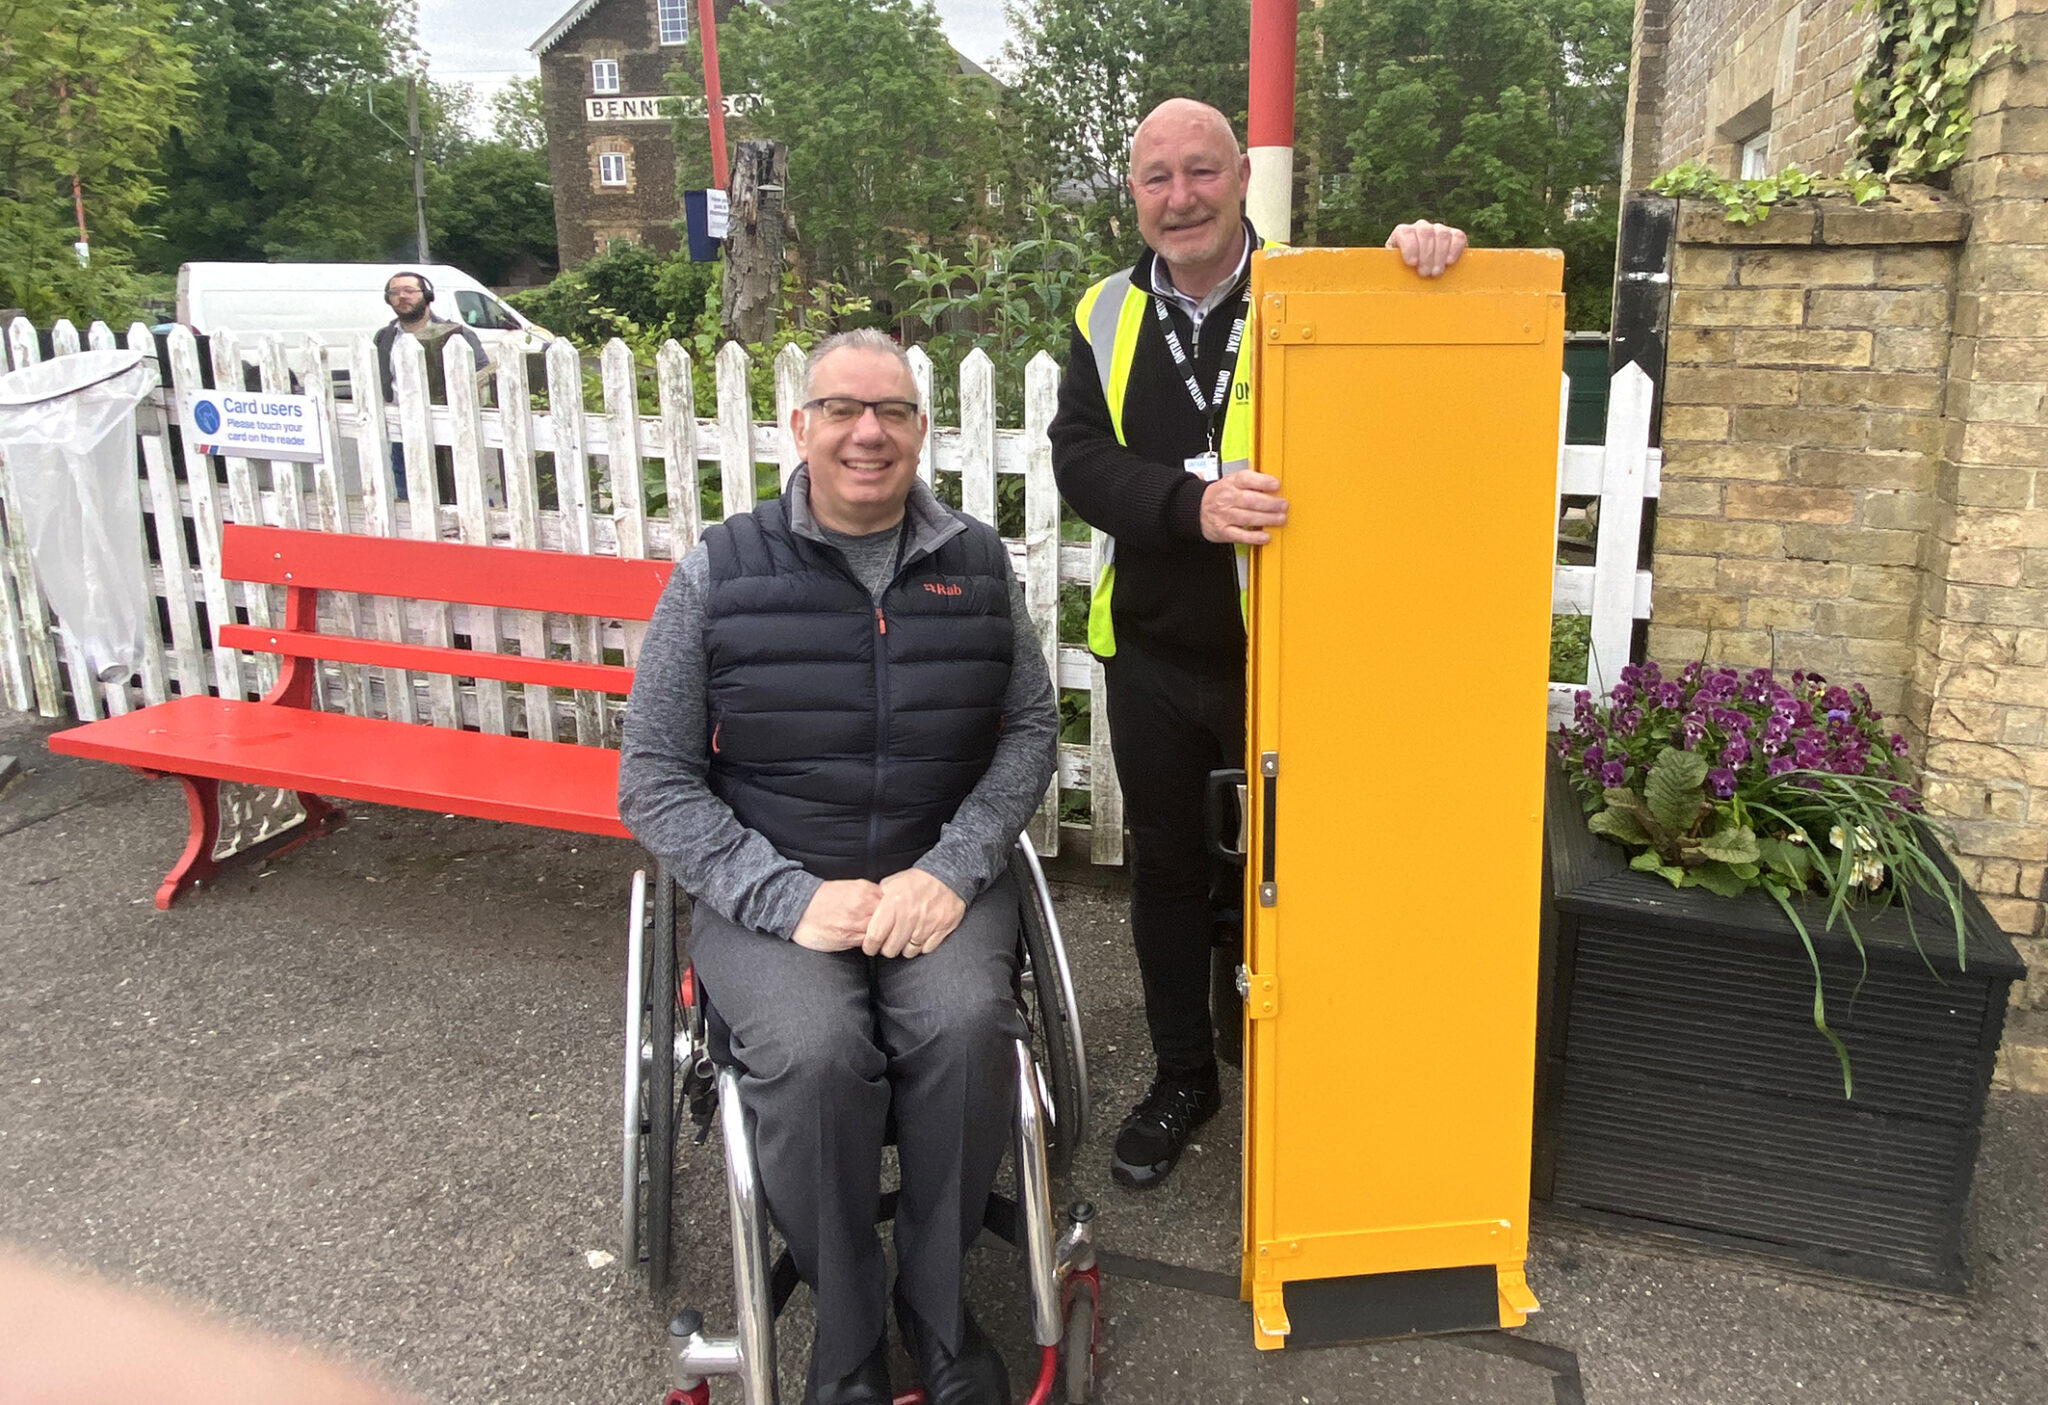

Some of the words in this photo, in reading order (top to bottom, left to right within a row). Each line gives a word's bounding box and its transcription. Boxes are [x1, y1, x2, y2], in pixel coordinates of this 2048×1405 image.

[1165, 330, 1187, 365] ONTRAK
[1225, 318, 1246, 353] ONTRAK
[1185, 375, 1207, 411] ONTRAK
[1211, 369, 1231, 405] ONTRAK
[223, 397, 258, 414] Card
[260, 402, 303, 417] users
[226, 418, 256, 429] Please
[256, 420, 282, 431] touch
[283, 423, 303, 433] your
[227, 432, 247, 441] card
[248, 433, 260, 442] on
[261, 433, 275, 443] the
[276, 436, 305, 446] reader
[937, 584, 962, 595] Rab
